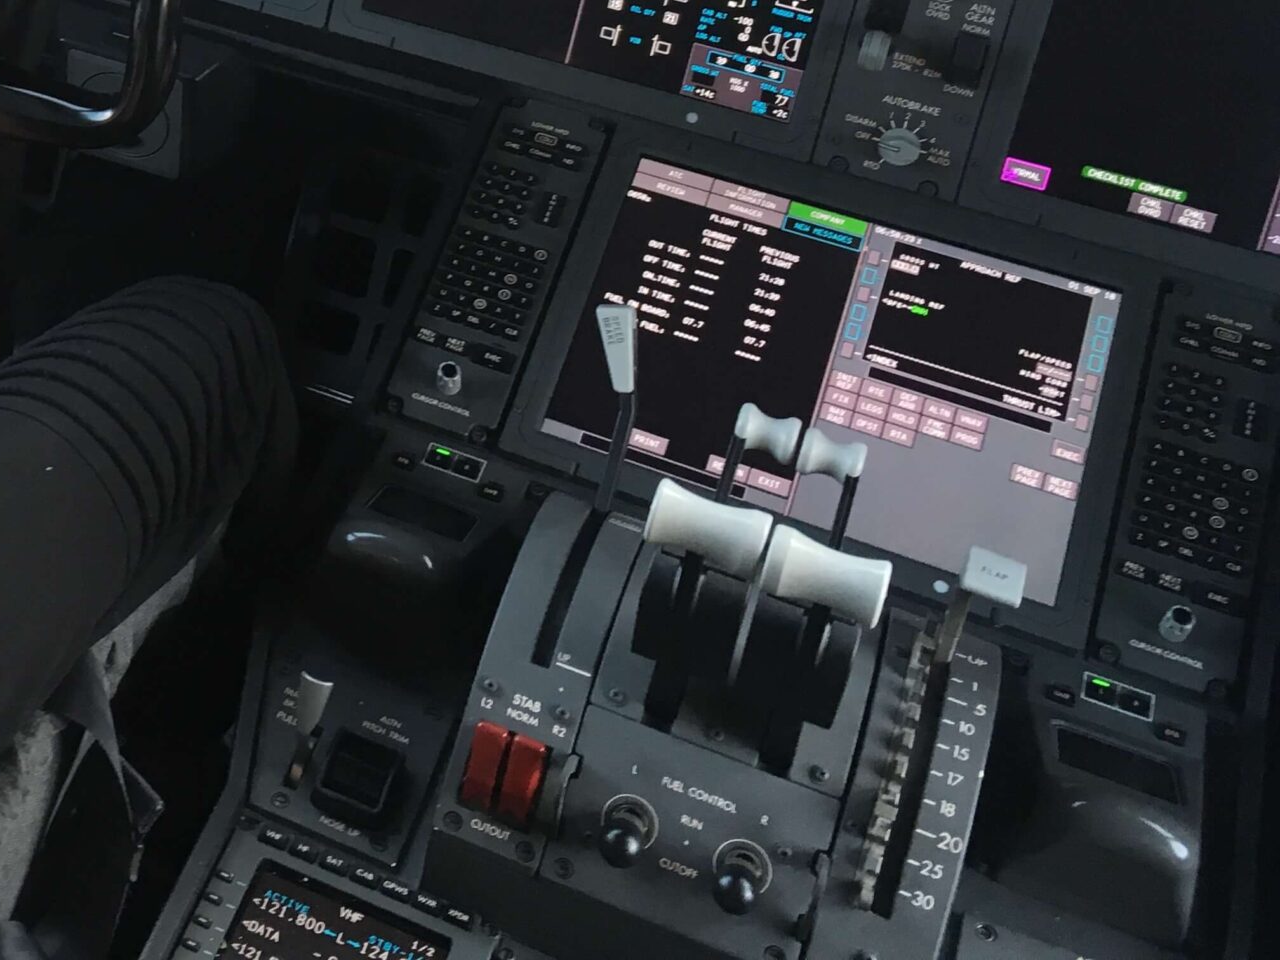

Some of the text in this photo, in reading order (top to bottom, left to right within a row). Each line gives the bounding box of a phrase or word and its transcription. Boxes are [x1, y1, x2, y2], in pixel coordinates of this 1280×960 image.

[965, 11, 995, 26] GEAR
[943, 82, 975, 99] DOWN
[881, 94, 943, 118] AUTOBRAKE
[1087, 167, 1184, 202] CHECKLIST COMPLETE
[709, 213, 768, 237] FLIGHT TIMES
[759, 245, 801, 263] PREVIOUS
[480, 696, 494, 710] L2
[512, 693, 543, 714] STAB
[972, 703, 987, 717] 5
[505, 707, 540, 728] NORM
[551, 723, 567, 739] R2
[958, 720, 976, 737] 10
[952, 744, 971, 762] 15
[946, 771, 965, 787] 17
[660, 775, 738, 815] FUEL CONTROL
[939, 798, 957, 818] 18
[469, 818, 511, 842] CUTOUT
[680, 814, 704, 832] RUN
[935, 832, 965, 854] 20
[658, 856, 700, 880] CUTOFF
[919, 860, 945, 880] 25
[263, 889, 311, 913] ACTIVE
[910, 890, 936, 911] 30
[338, 905, 365, 923] VHF
[410, 939, 437, 958] 1/2
